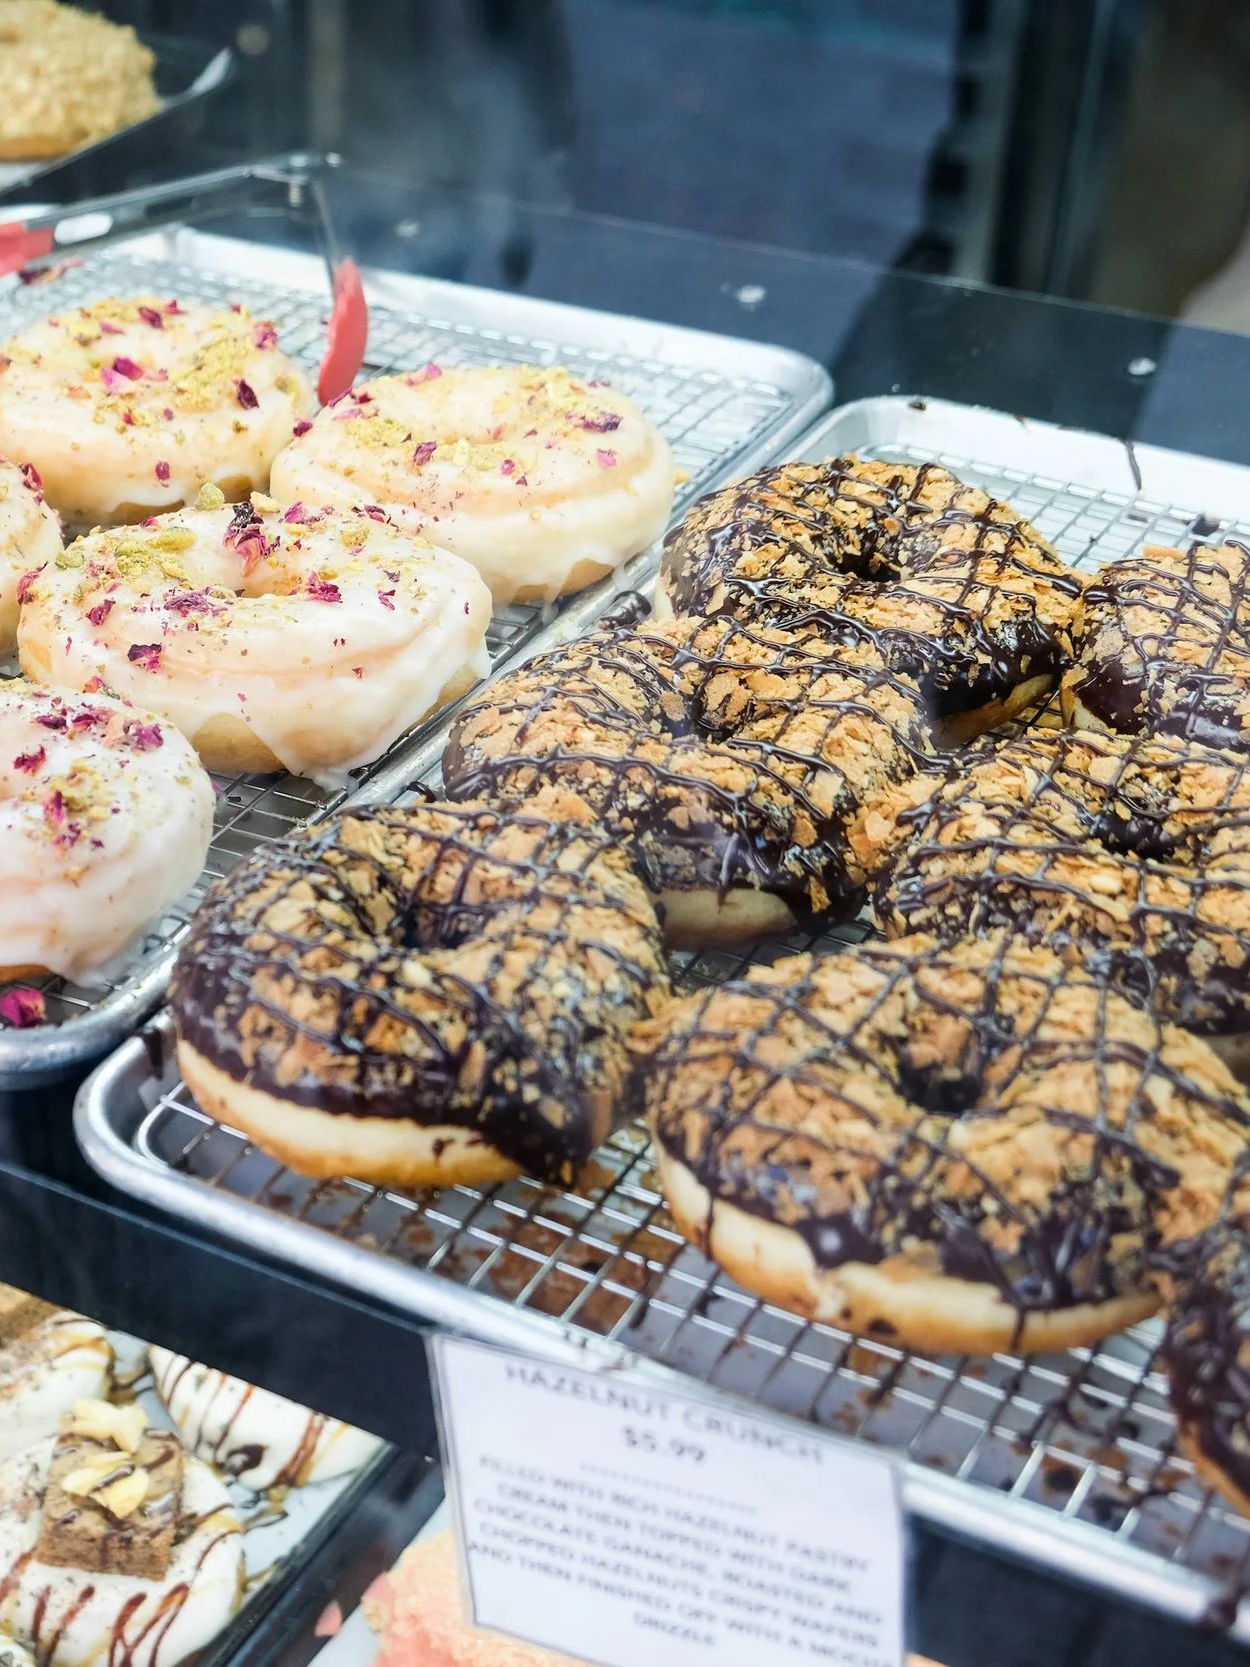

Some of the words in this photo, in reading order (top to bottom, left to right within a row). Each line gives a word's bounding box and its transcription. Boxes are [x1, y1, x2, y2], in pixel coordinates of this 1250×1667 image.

[505, 1362, 668, 1420] HAZELNUT
[682, 1406, 823, 1465] CRUNCH
[623, 1425, 705, 1463] $5.99
[473, 1496, 597, 1544] CHOCOLATE
[721, 1567, 824, 1607] ROASTED
[831, 1601, 884, 1626] AND
[479, 1454, 545, 1482] FILLED
[552, 1475, 604, 1500] WITH
[610, 1490, 659, 1515] RICH
[665, 1508, 778, 1548] HAZELNUT
[786, 1539, 871, 1572] PASTRY
[498, 1481, 568, 1512] CREAM
[576, 1504, 631, 1530] THEN
[639, 1521, 722, 1556] TOPPED
[727, 1548, 785, 1573] WITH
[790, 1564, 851, 1594] DARK
[468, 1541, 513, 1563] AND
[518, 1555, 572, 1583] THEN
[577, 1570, 671, 1611] FINISHED
[677, 1602, 718, 1623] OFF
[723, 1617, 782, 1643] WITH
[788, 1634, 802, 1649] A
[479, 1520, 576, 1560] CHOPPED
[581, 1552, 702, 1598] HAZELNUTS
[707, 1588, 782, 1620] CRISPY
[788, 1613, 879, 1648] WAFERS
[632, 1611, 717, 1646] DRIZZLE
